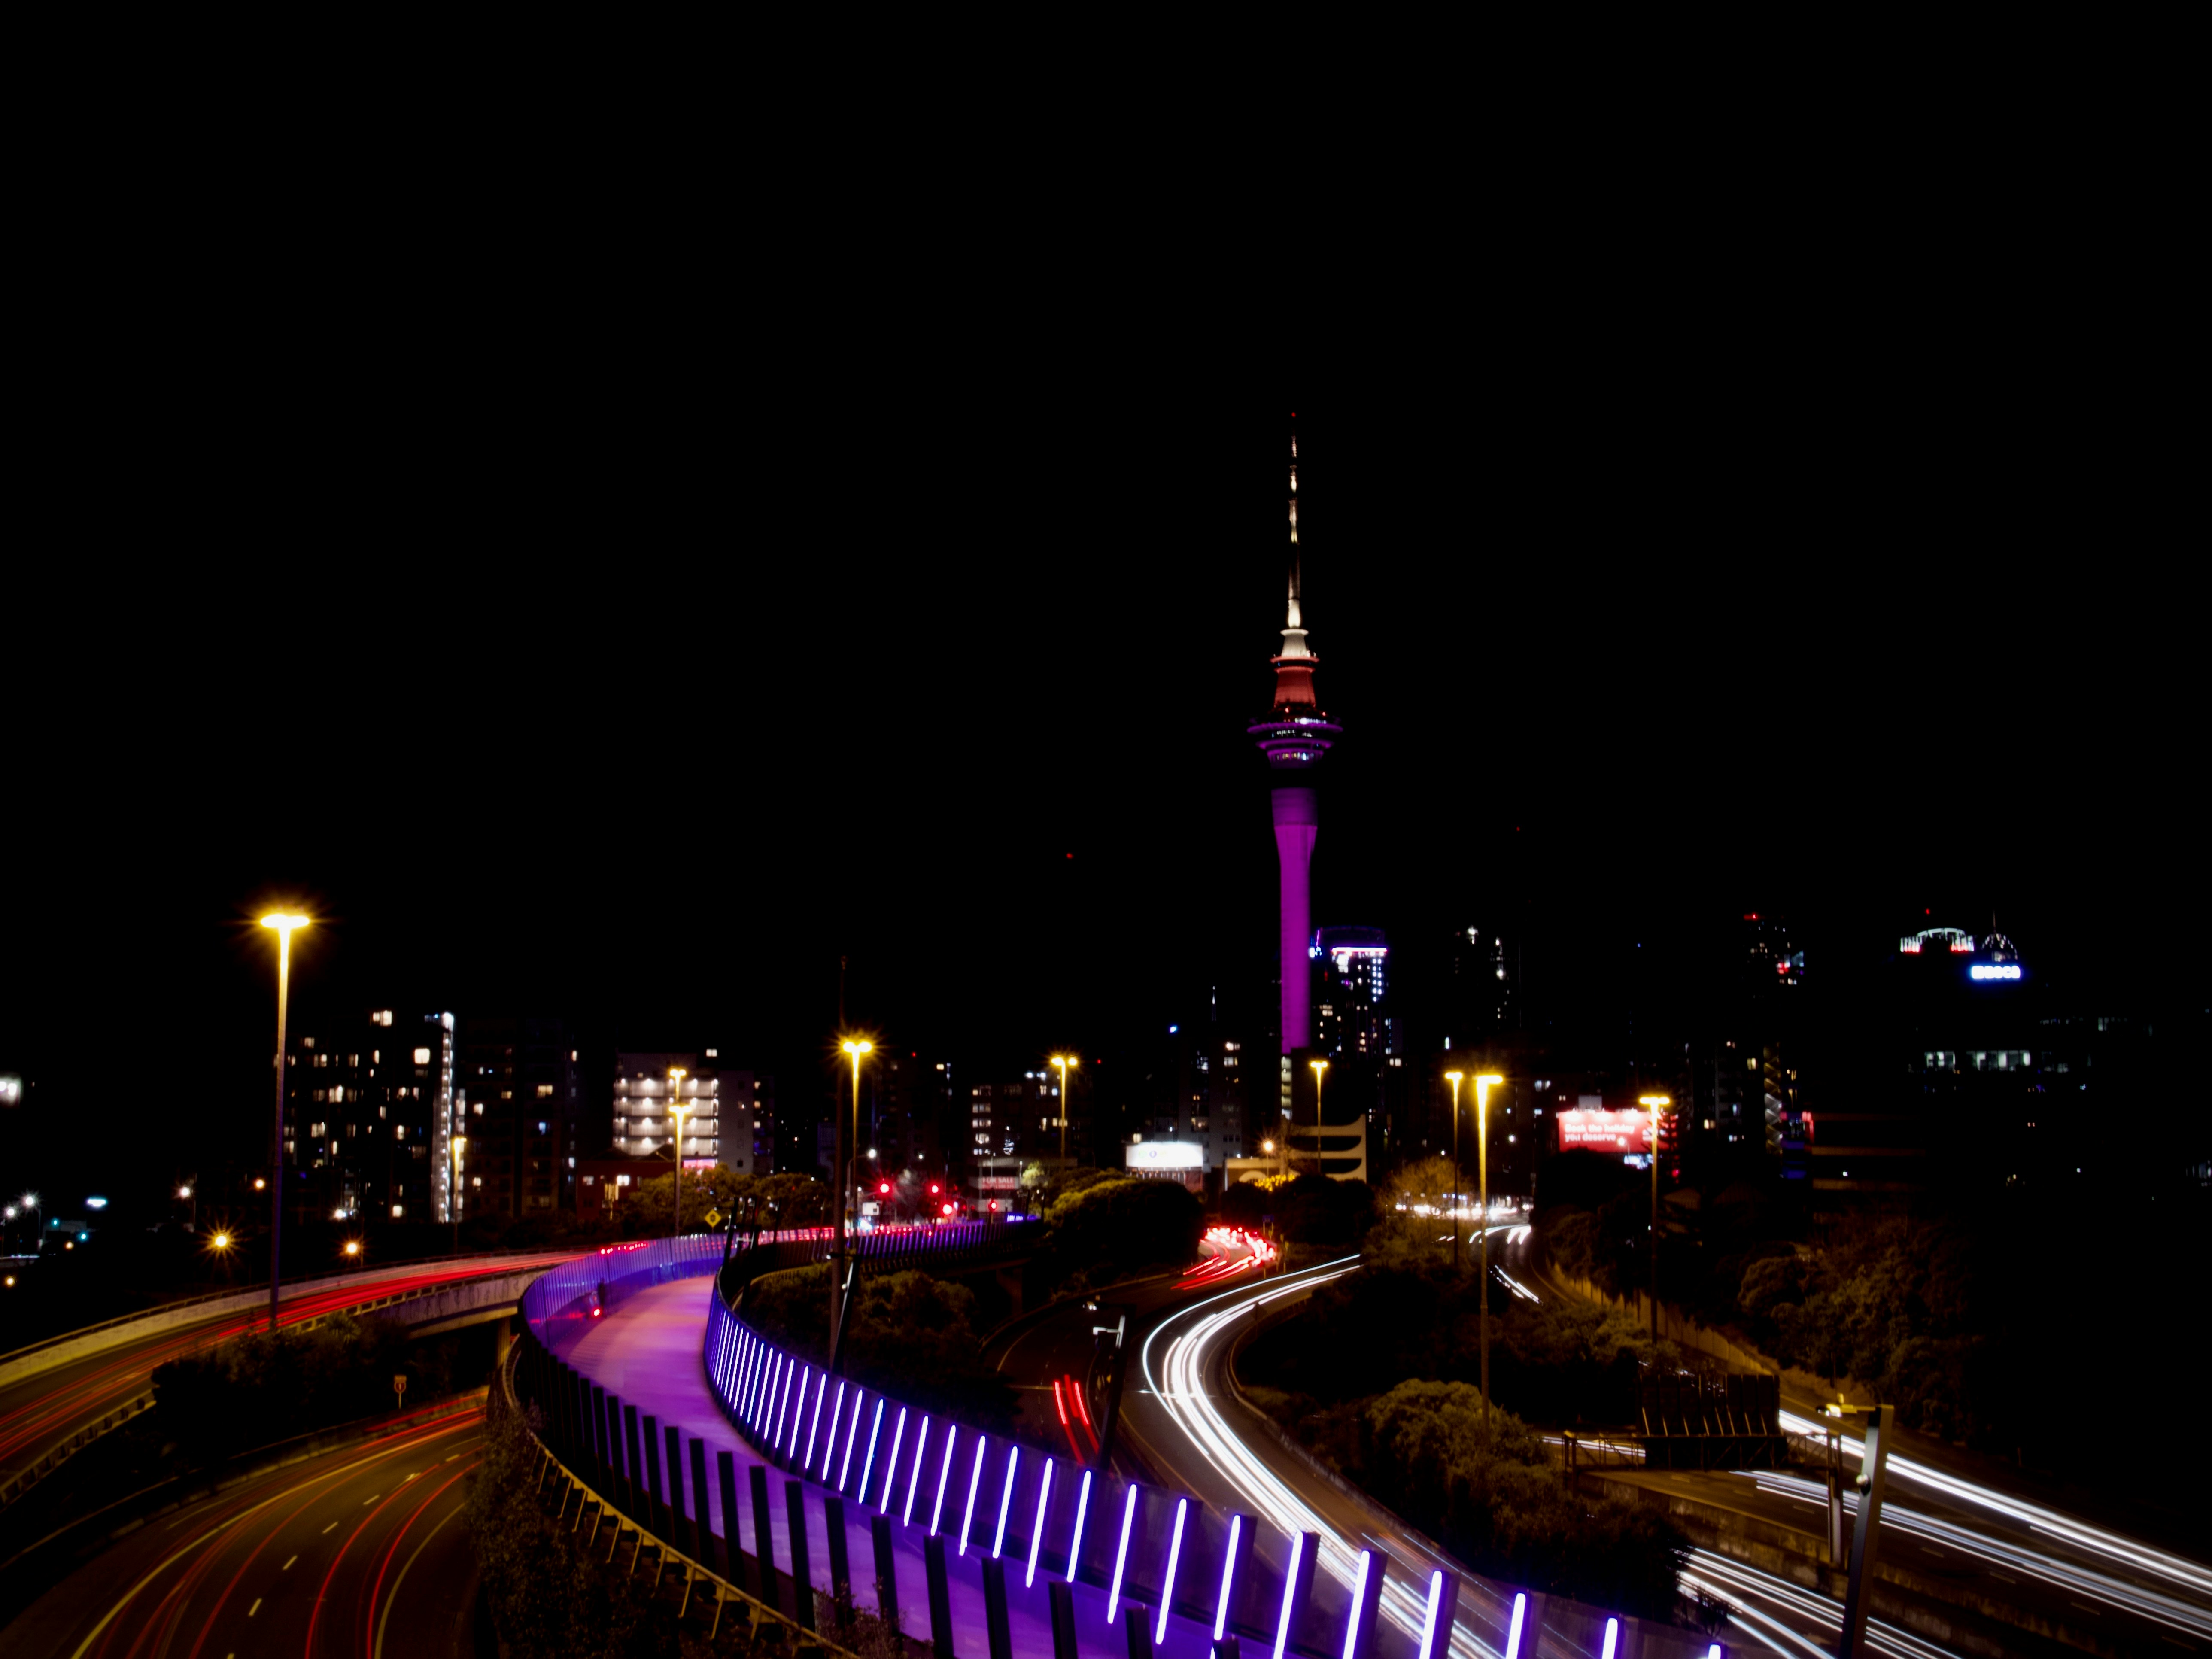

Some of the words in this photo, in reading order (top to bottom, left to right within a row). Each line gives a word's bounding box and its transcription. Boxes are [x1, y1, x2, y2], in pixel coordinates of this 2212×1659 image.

[1589, 1124, 1602, 1133] the
[1604, 1124, 1635, 1134] holiday
[1565, 1134, 1580, 1142] you
[1583, 1133, 1616, 1141] deserve
